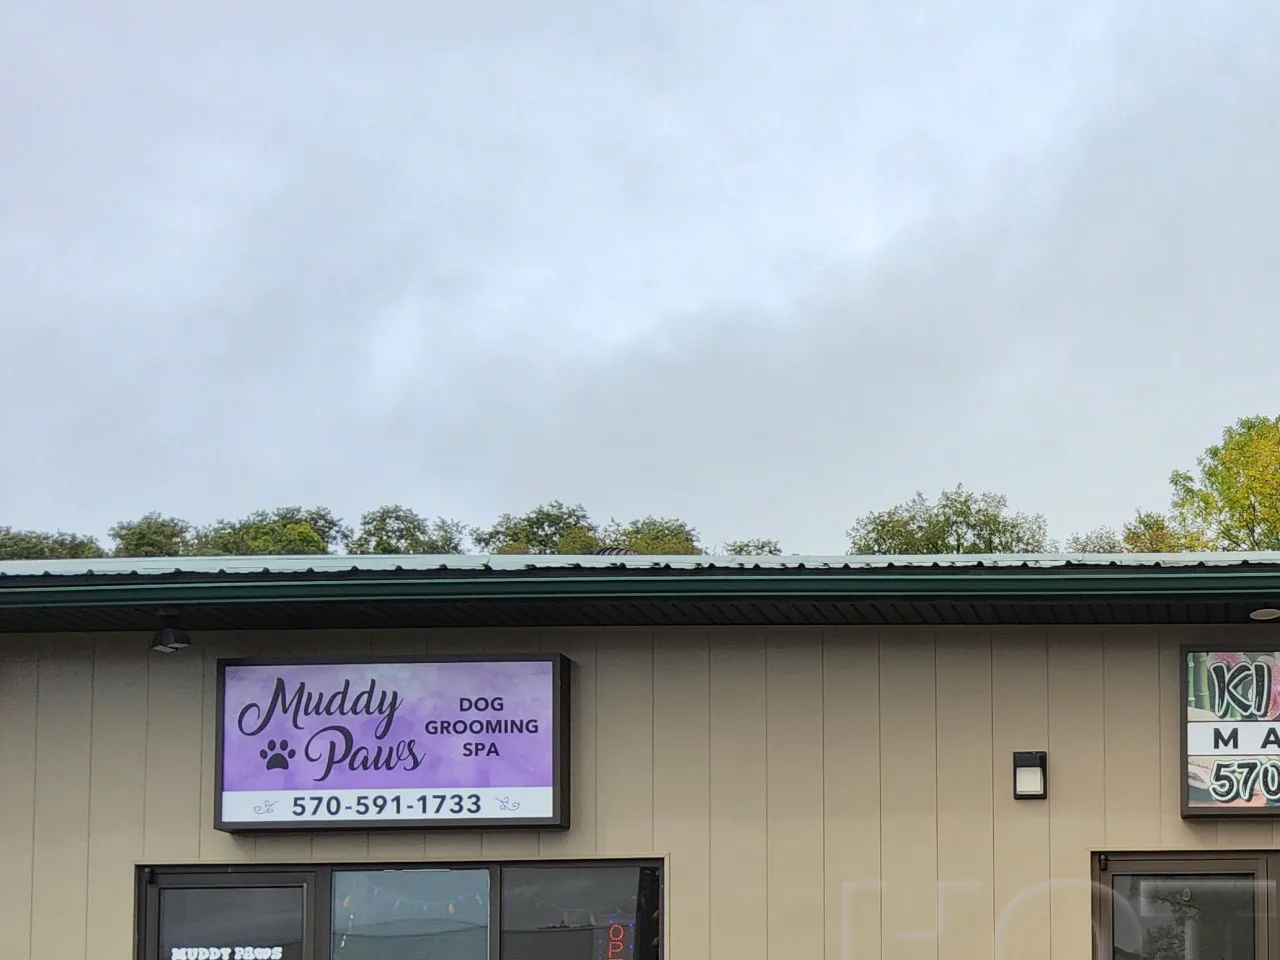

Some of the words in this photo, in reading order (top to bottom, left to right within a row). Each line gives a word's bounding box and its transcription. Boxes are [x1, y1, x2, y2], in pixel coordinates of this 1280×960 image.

[1208, 661, 1271, 717] KI
[237, 677, 403, 740] Muddy
[459, 696, 504, 712] DOG
[424, 719, 539, 735] GROOMING
[304, 725, 426, 782] Paws
[462, 742, 500, 757] SPA
[291, 794, 482, 816] 570-591-1733
[171, 947, 232, 960] MUDDY
[234, 946, 283, 960] PAWS
